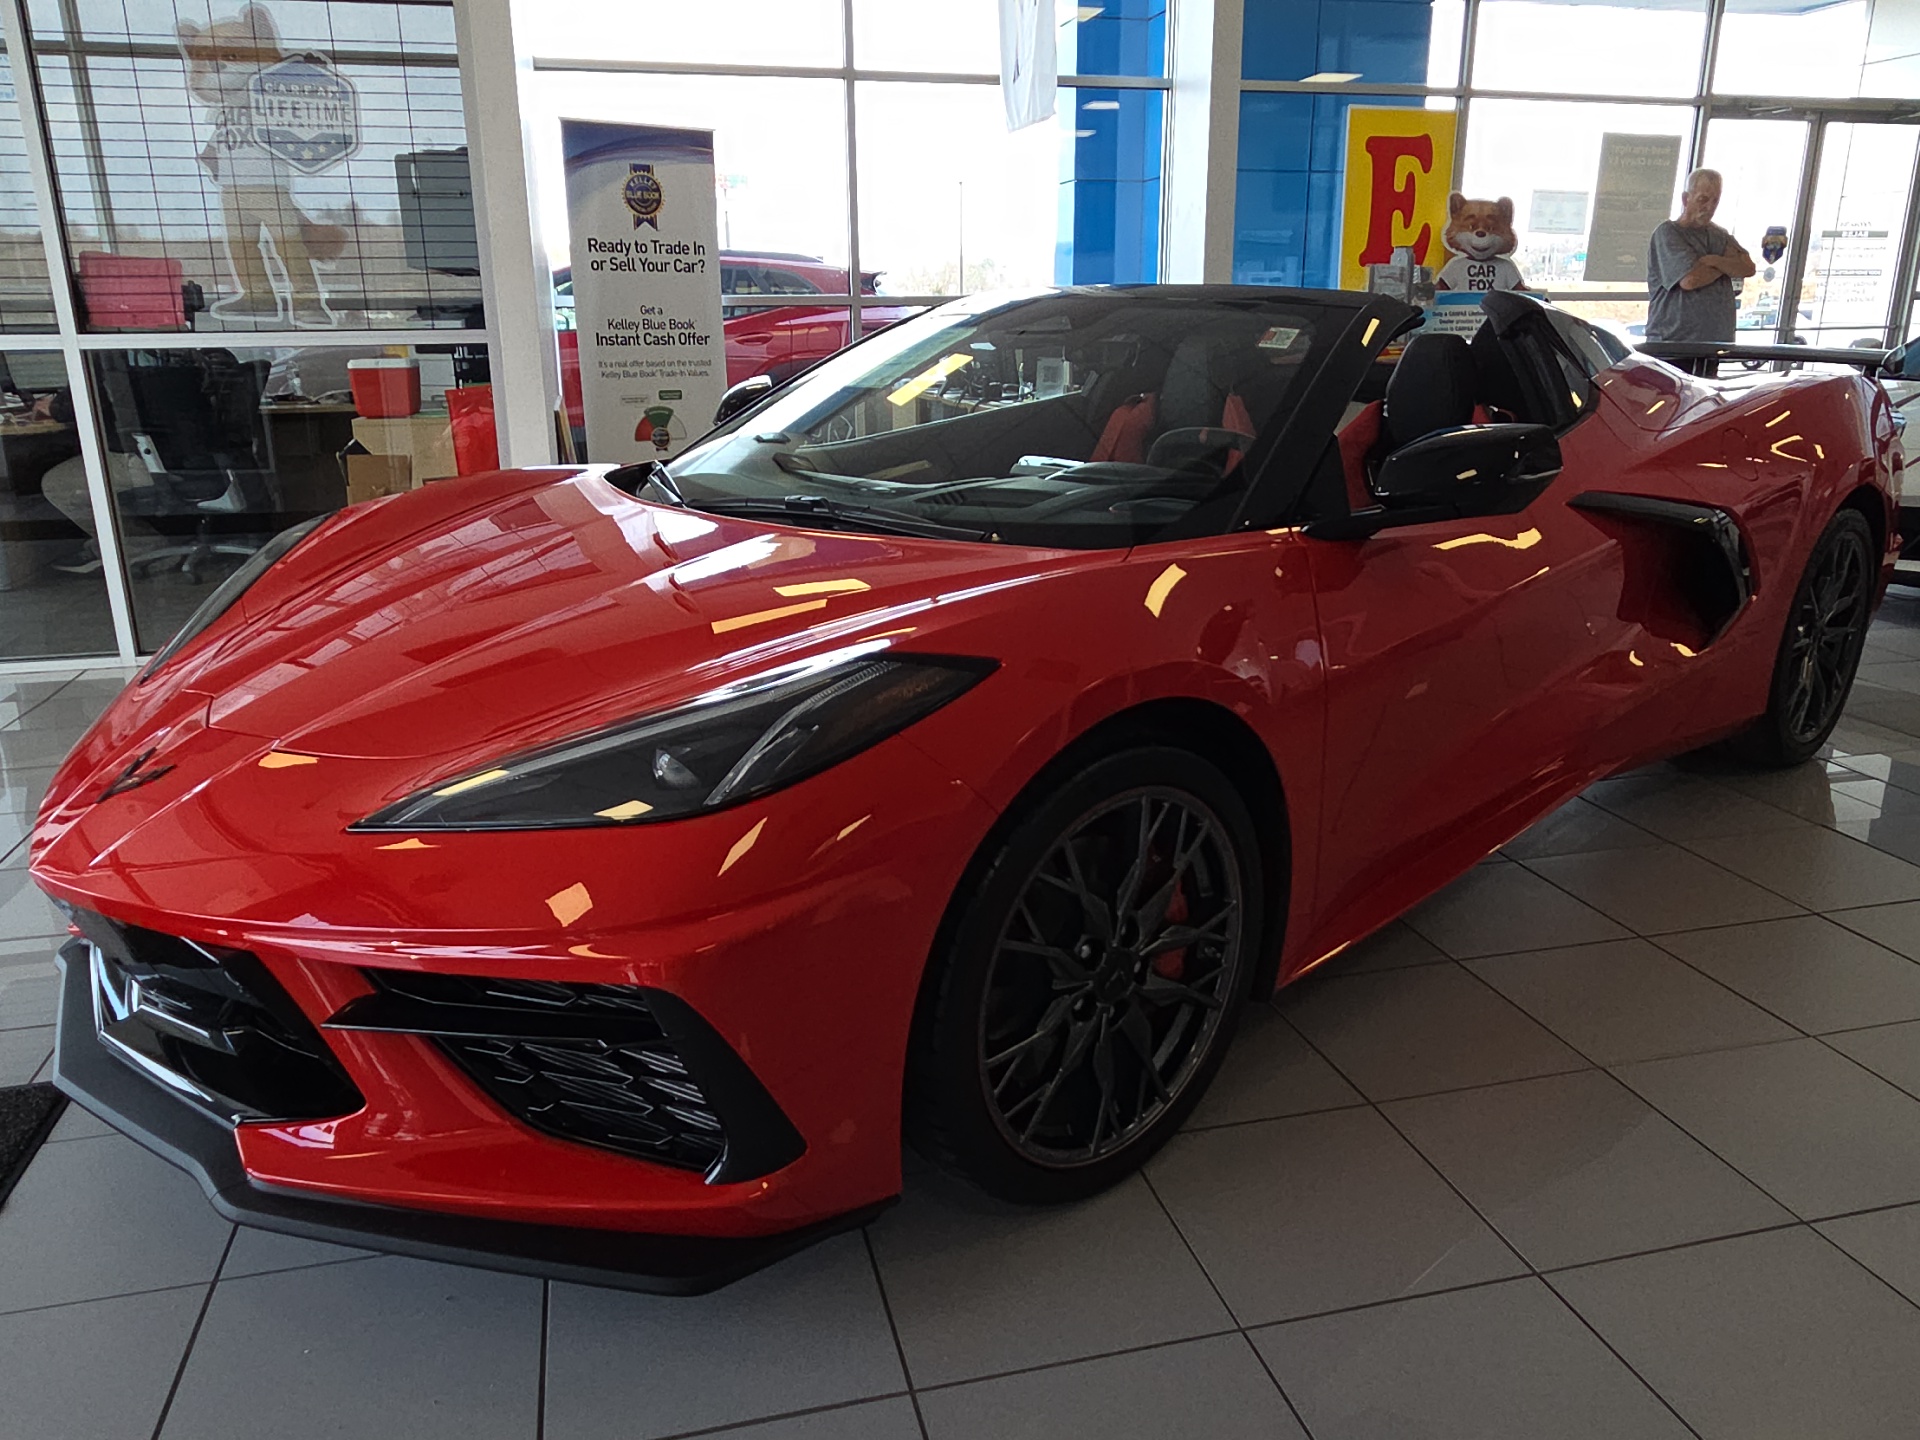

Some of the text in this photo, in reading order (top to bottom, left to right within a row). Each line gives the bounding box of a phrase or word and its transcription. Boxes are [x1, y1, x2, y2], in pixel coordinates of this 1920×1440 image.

[254, 97, 352, 124] LIFETIME
[587, 238, 706, 257] Ready to Trade In
[590, 257, 705, 273] or Sell Your Car?
[1466, 264, 1496, 278] CAR
[1468, 279, 1495, 291] FOX
[640, 304, 663, 316] Get a
[607, 318, 640, 333] Kelley
[642, 318, 667, 330] Blue
[595, 332, 711, 346] Instant Cash Offer
[614, 360, 628, 368] real
[629, 360, 644, 368] offer
[645, 359, 667, 368] based
[667, 360, 676, 368] on
[676, 359, 687, 368] the
[688, 359, 712, 368] trusted
[601, 370, 621, 380] Kelley
[622, 370, 638, 379] Blue
